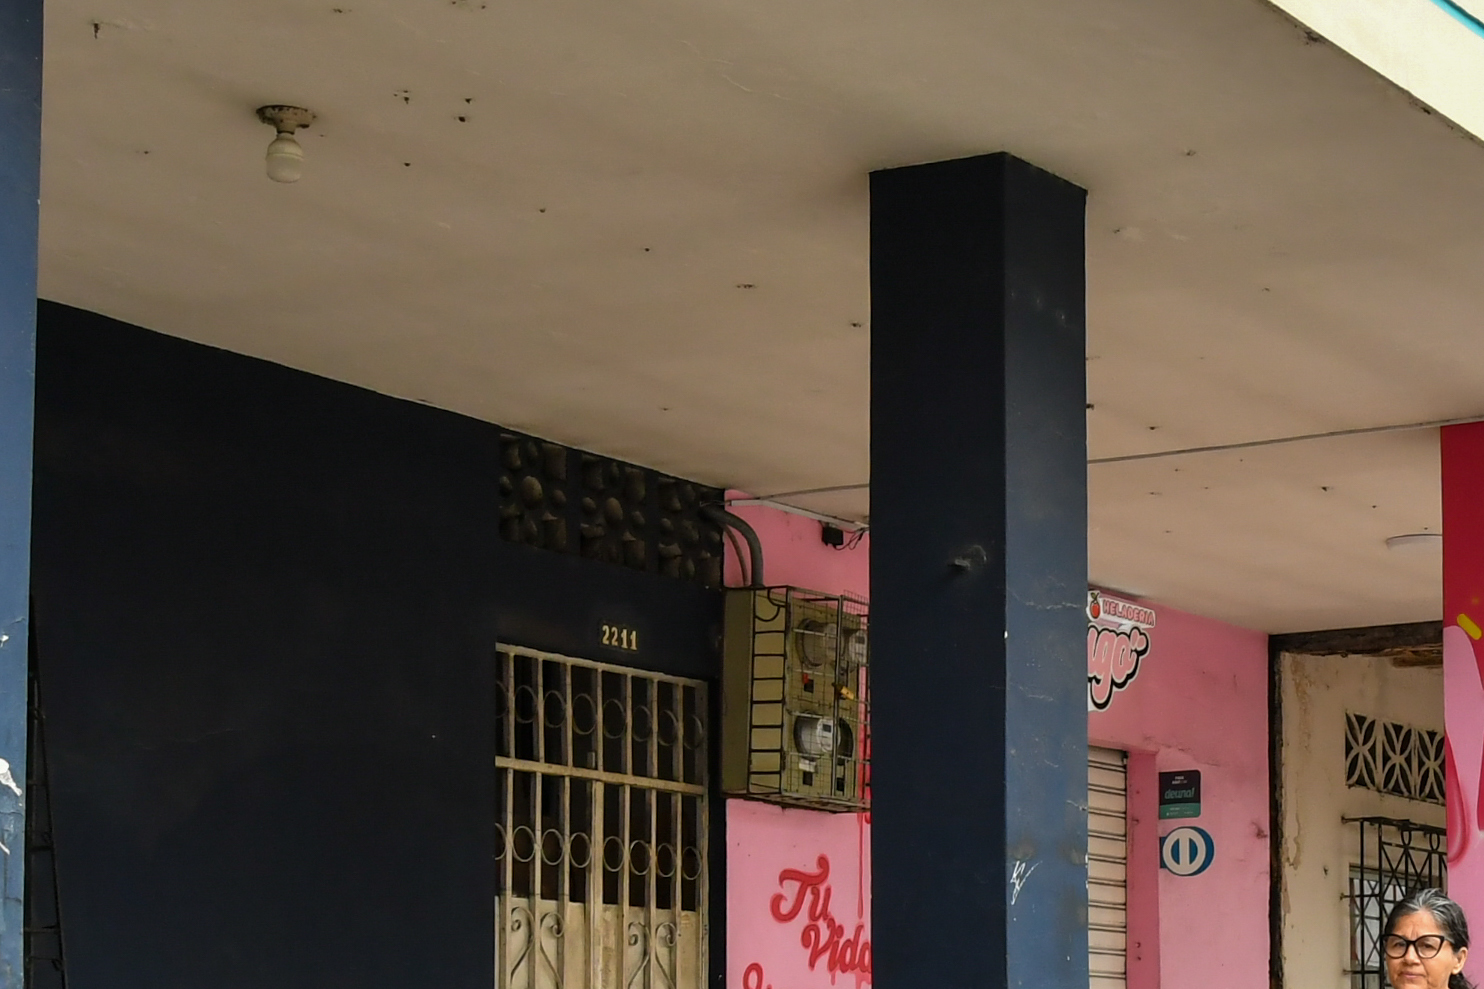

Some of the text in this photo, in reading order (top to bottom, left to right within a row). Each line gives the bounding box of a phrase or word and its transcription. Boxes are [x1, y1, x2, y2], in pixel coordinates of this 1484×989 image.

[1102, 599, 1155, 626] HELADERIA
[602, 625, 638, 650] 2211
[769, 853, 831, 924] Tu
